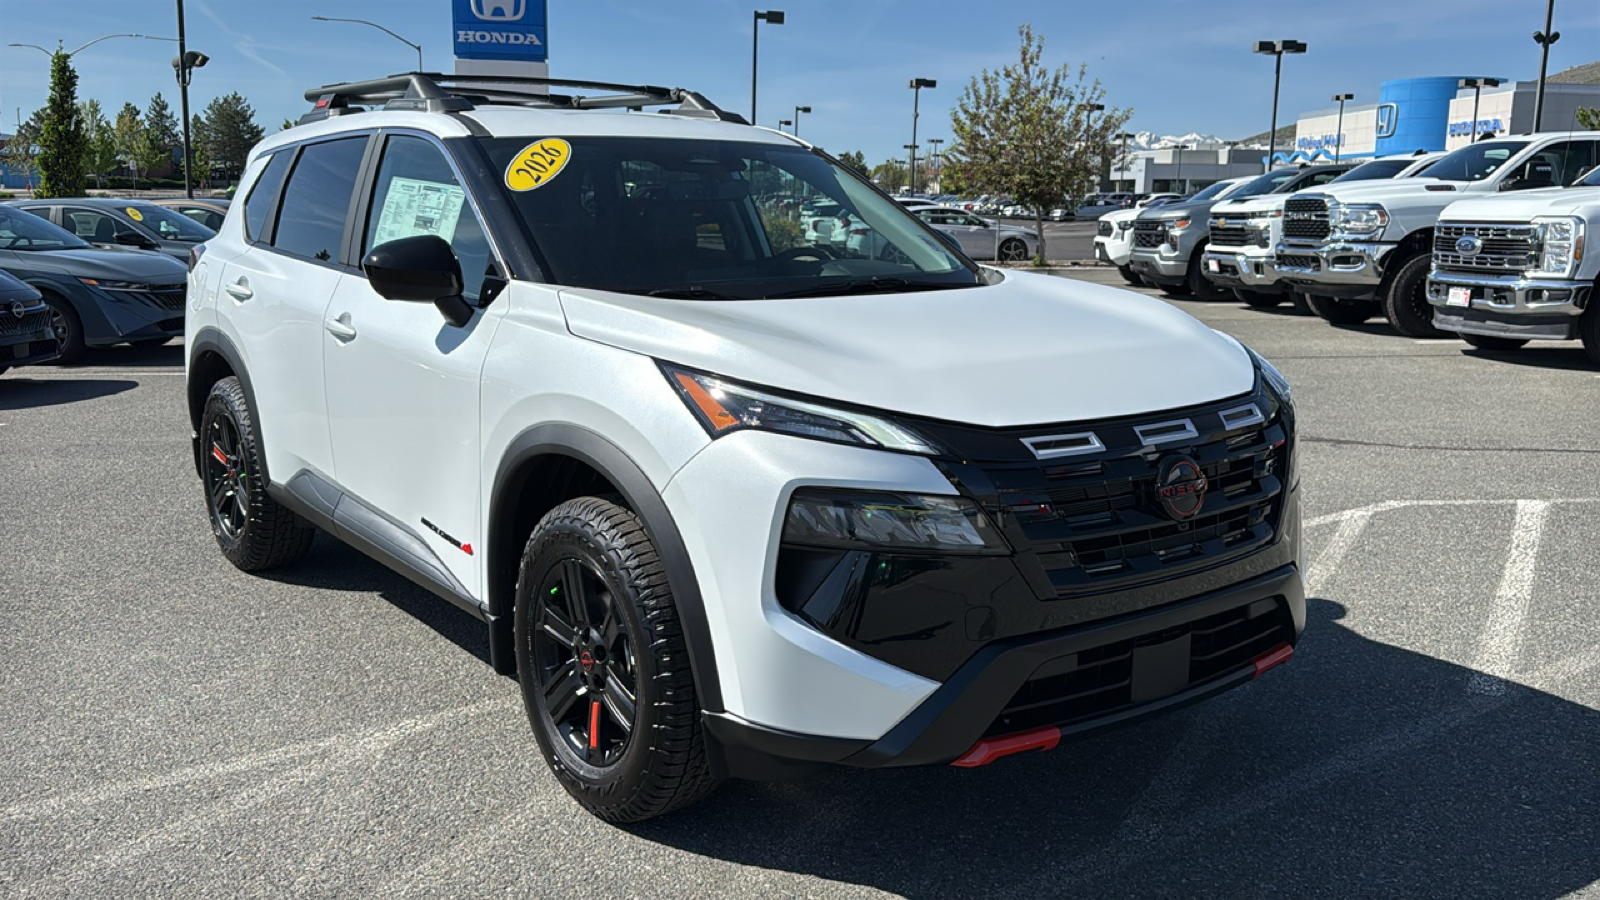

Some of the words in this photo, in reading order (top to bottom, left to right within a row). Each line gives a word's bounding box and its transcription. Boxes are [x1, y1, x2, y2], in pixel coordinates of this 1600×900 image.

[457, 31, 542, 45] HONDA
[515, 143, 562, 184] 2026
[1159, 480, 1206, 497] NISS
